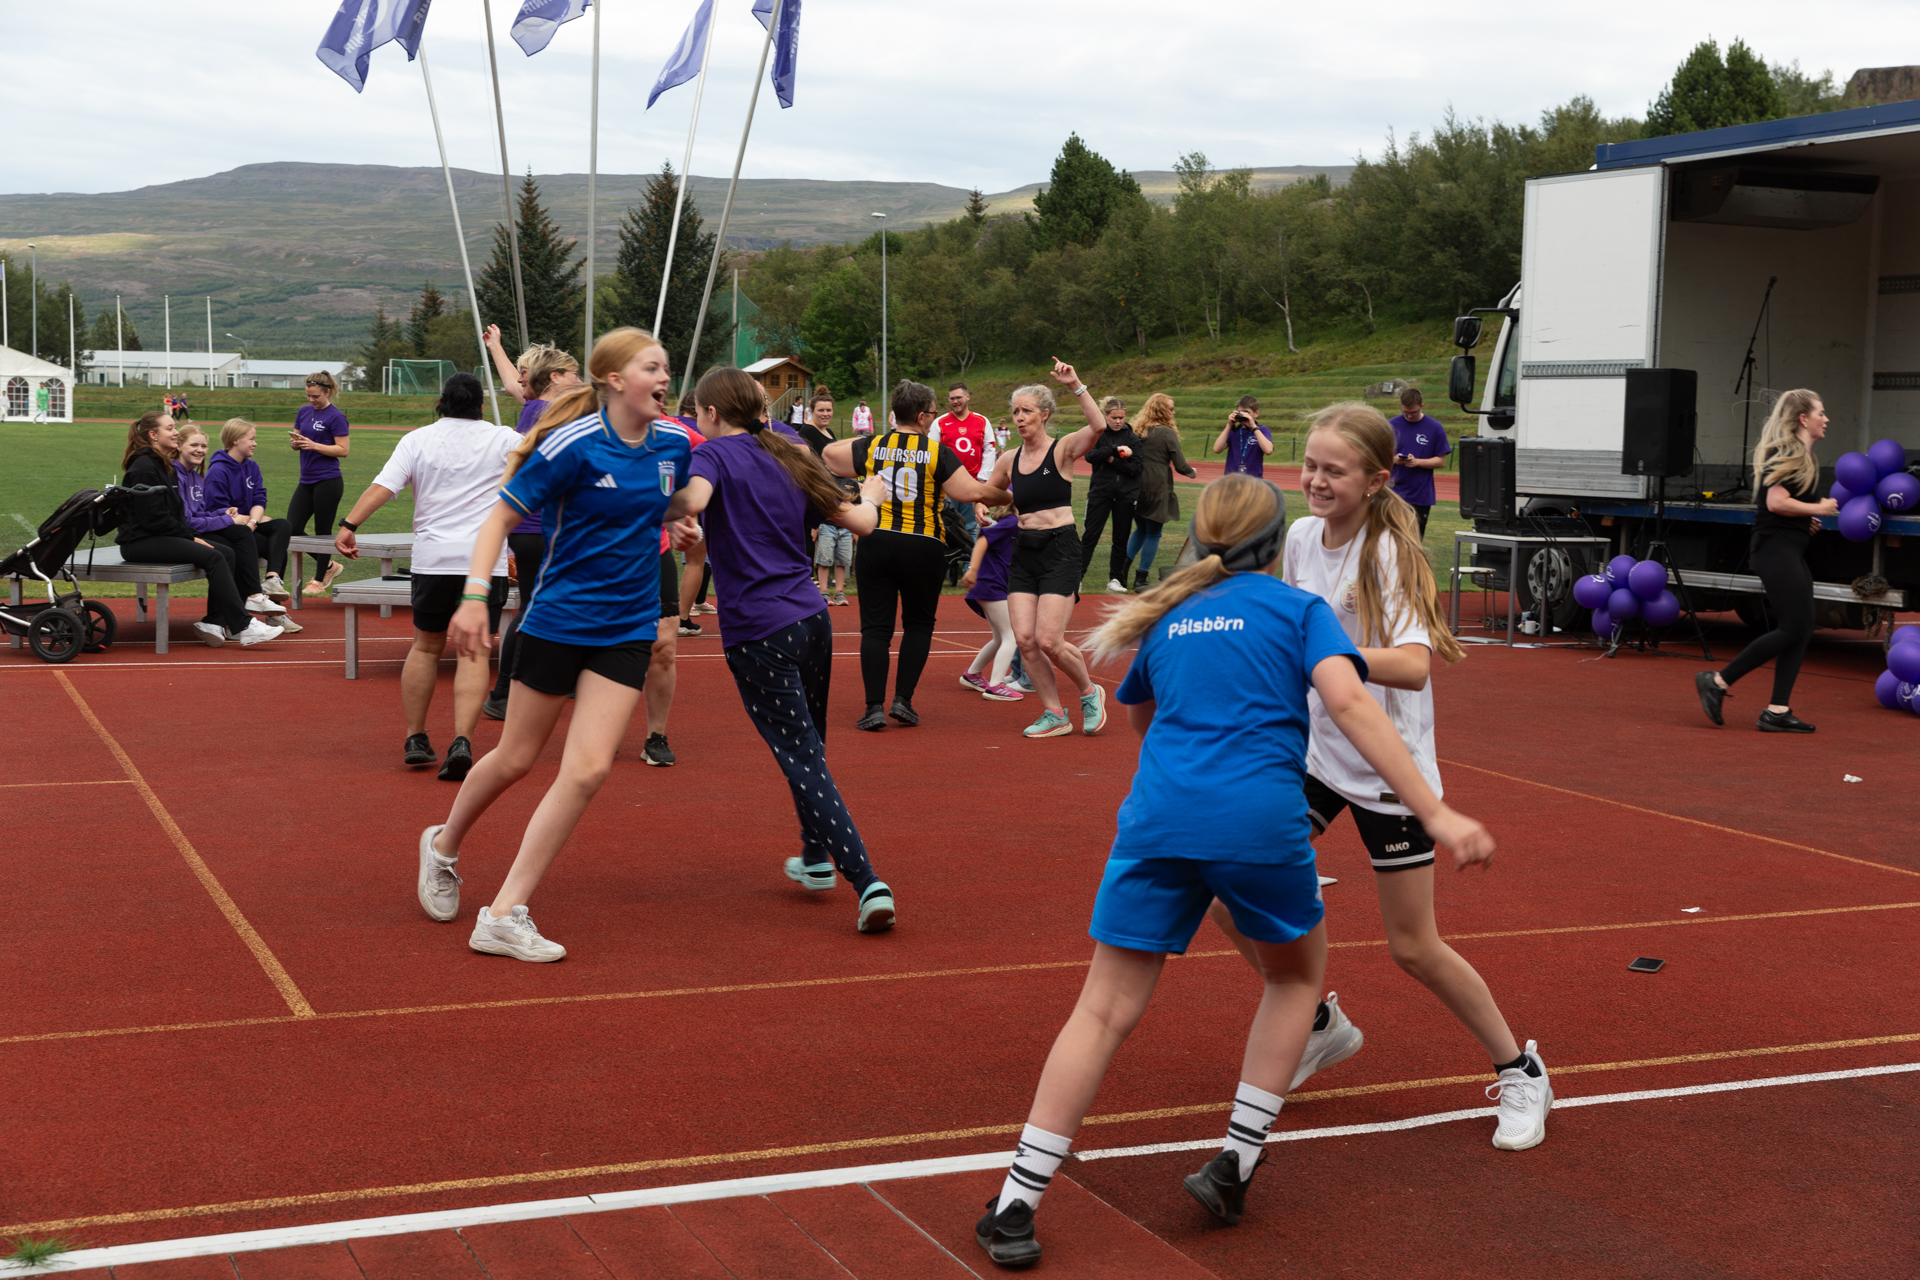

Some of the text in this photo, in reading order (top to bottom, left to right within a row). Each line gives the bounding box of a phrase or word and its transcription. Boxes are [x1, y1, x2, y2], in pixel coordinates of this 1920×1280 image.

[872, 446, 932, 465] ADLERSSON
[955, 437, 976, 457] O2
[878, 465, 918, 502] 10
[1168, 615, 1244, 640] Pálsbörn
